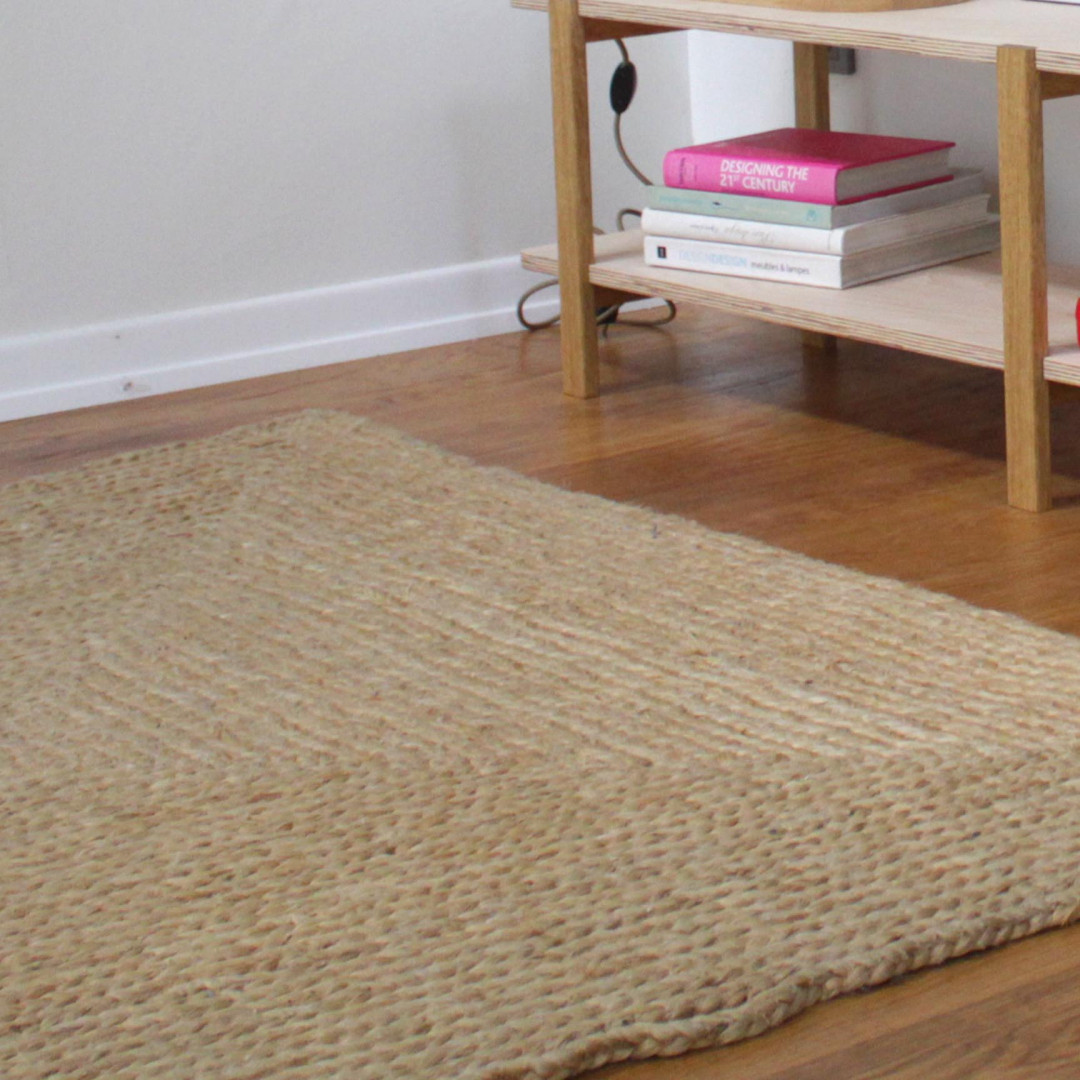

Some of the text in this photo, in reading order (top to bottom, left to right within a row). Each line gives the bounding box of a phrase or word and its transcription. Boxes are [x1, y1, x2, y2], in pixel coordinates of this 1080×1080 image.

[720, 159, 809, 181] DESIGNING THE
[742, 176, 796, 193] CENTURY
